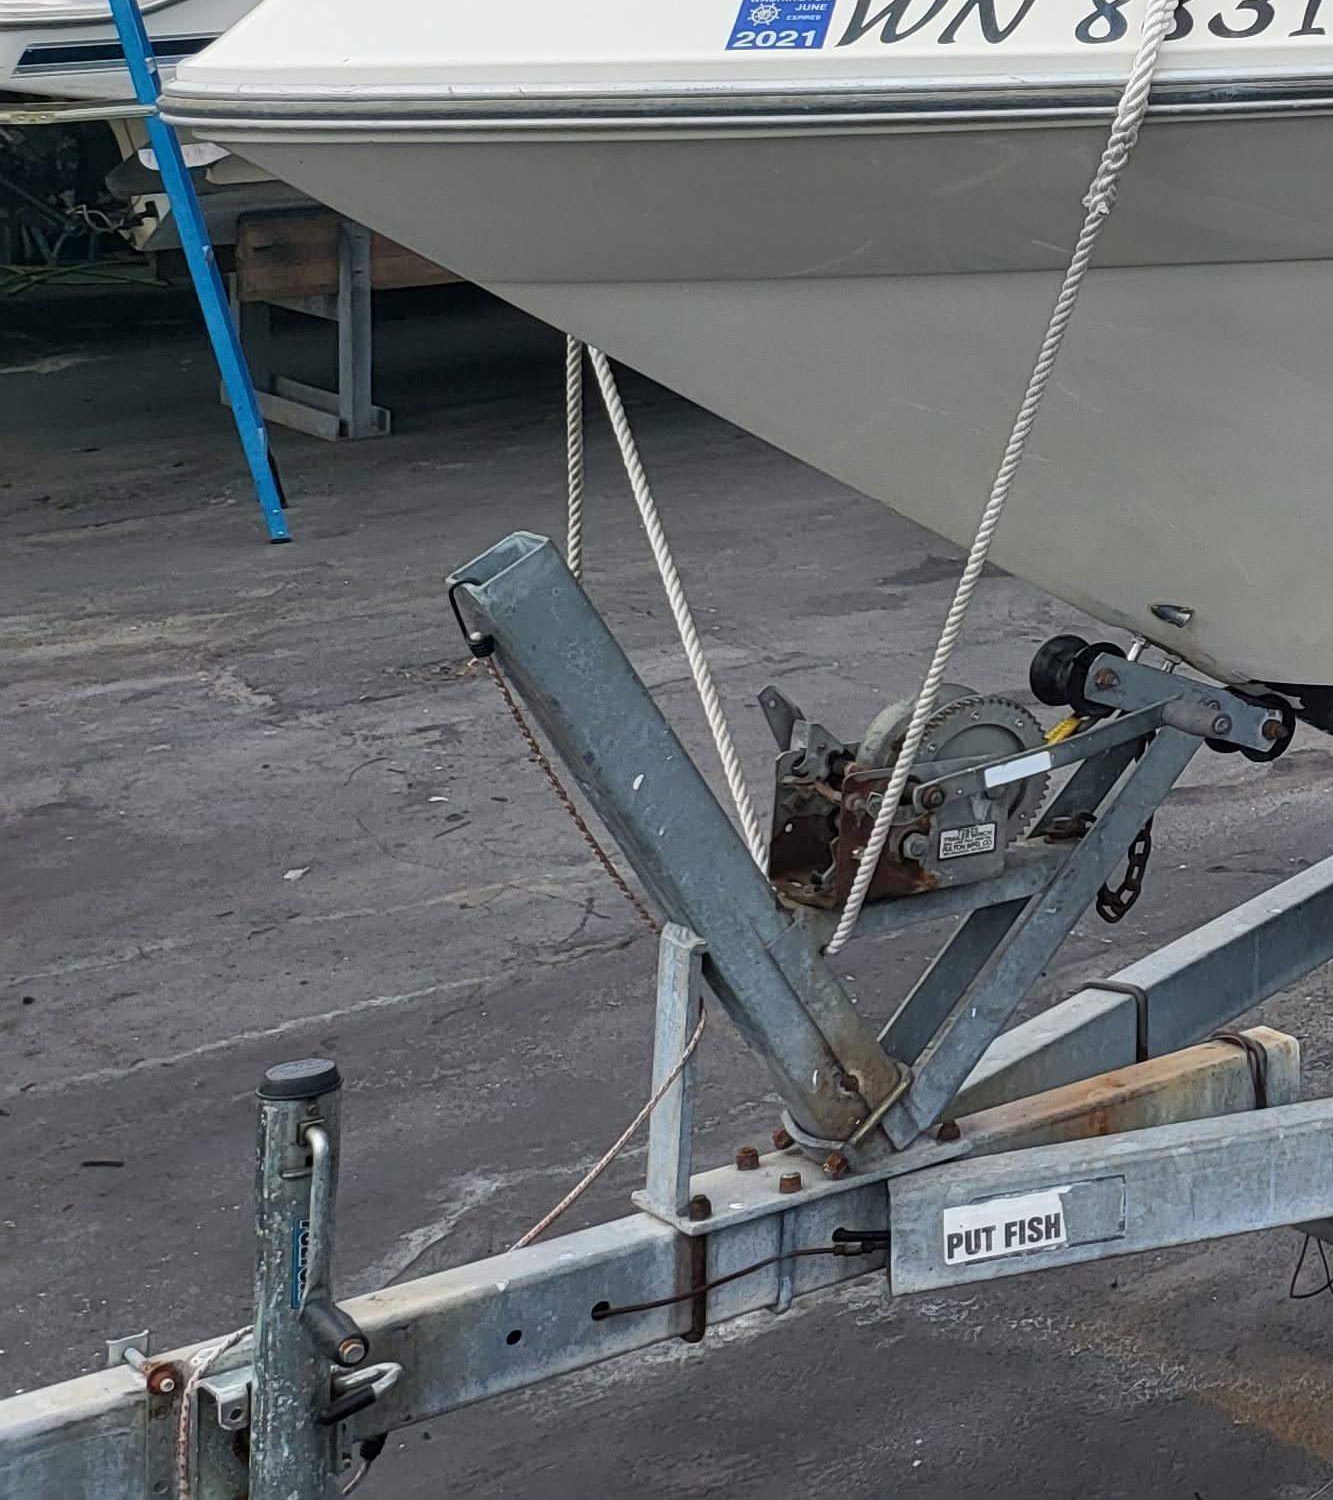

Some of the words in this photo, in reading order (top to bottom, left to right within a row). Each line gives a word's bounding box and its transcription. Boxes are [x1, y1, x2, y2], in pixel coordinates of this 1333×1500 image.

[795, 3, 828, 11] JUNE
[732, 30, 817, 47] 2021
[946, 1225, 996, 1260] PUT
[1005, 1212, 1061, 1248] FISH
